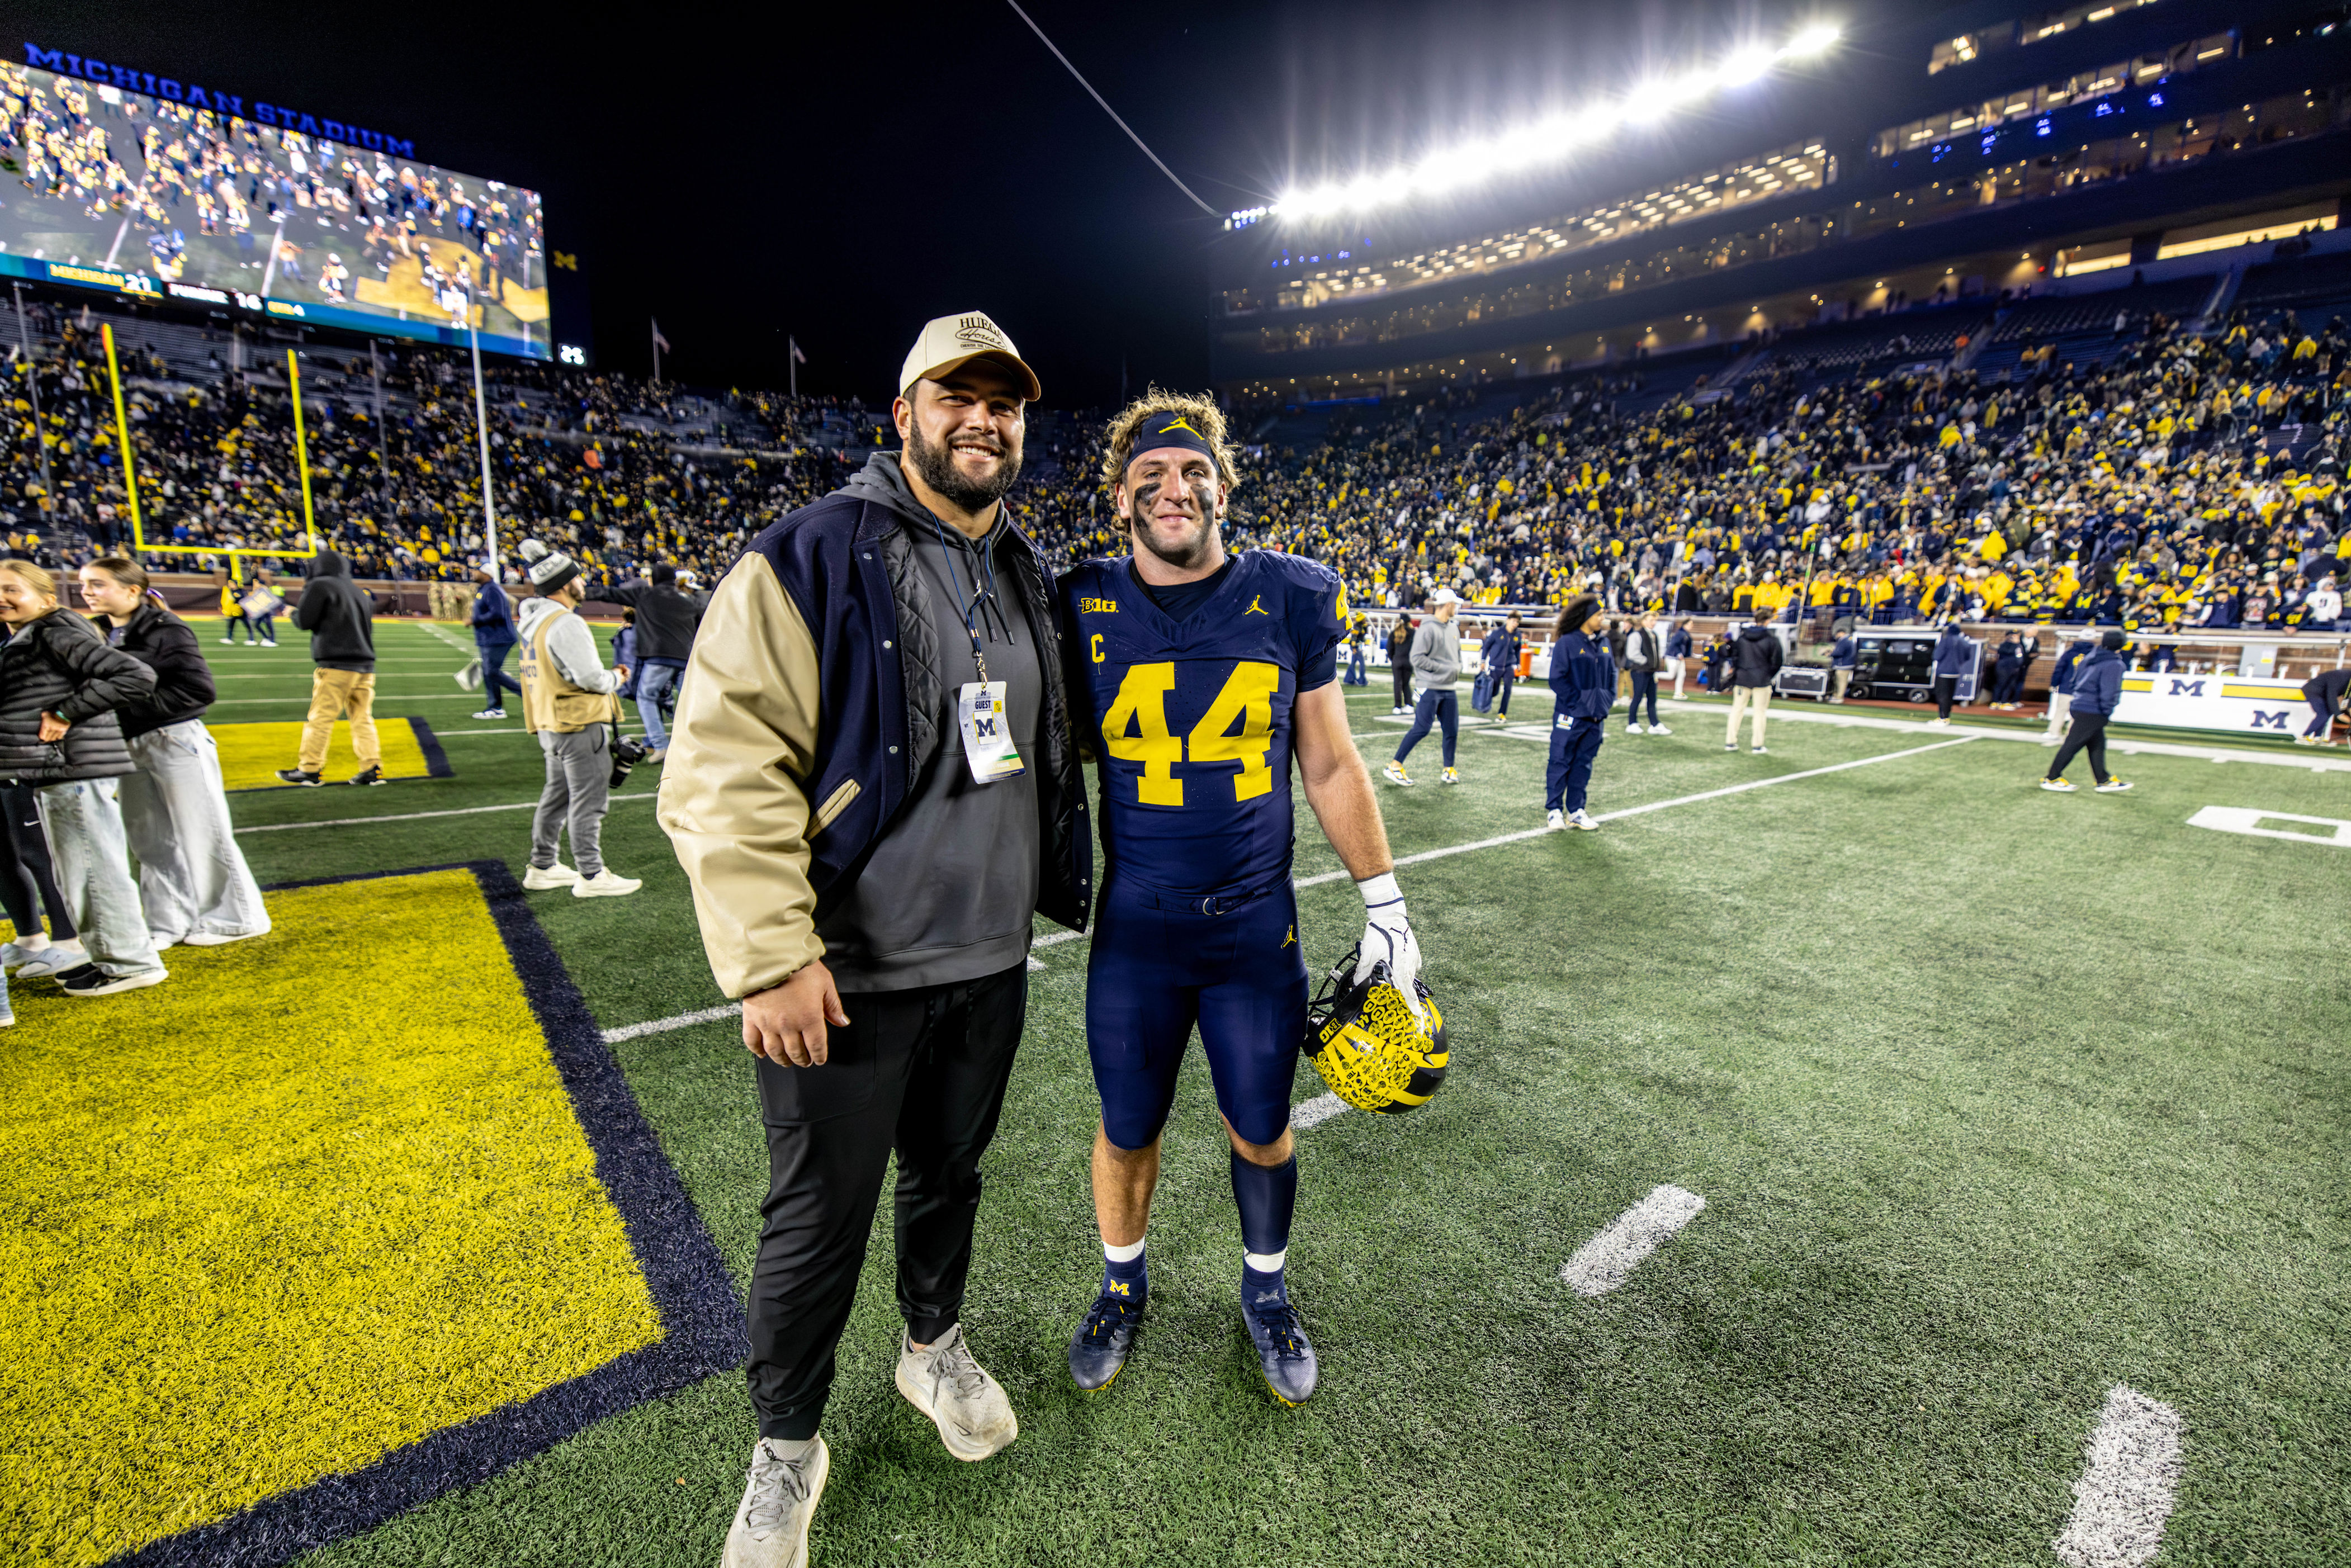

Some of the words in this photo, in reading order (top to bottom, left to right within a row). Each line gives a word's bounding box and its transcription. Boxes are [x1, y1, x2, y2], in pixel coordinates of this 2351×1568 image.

[23, 42, 245, 117] MICHIGAN
[254, 101, 416, 160] STADIUM
[960, 328, 1005, 348] House
[1091, 633, 1105, 664] C
[2169, 679, 2206, 697] M
[975, 700, 991, 709] GUEST
[975, 718, 996, 737] M
[2250, 710, 2290, 729] M
[1101, 661, 1279, 806] 44
[1347, 1070, 1356, 1079] TED
[1110, 1280, 1129, 1296] M
